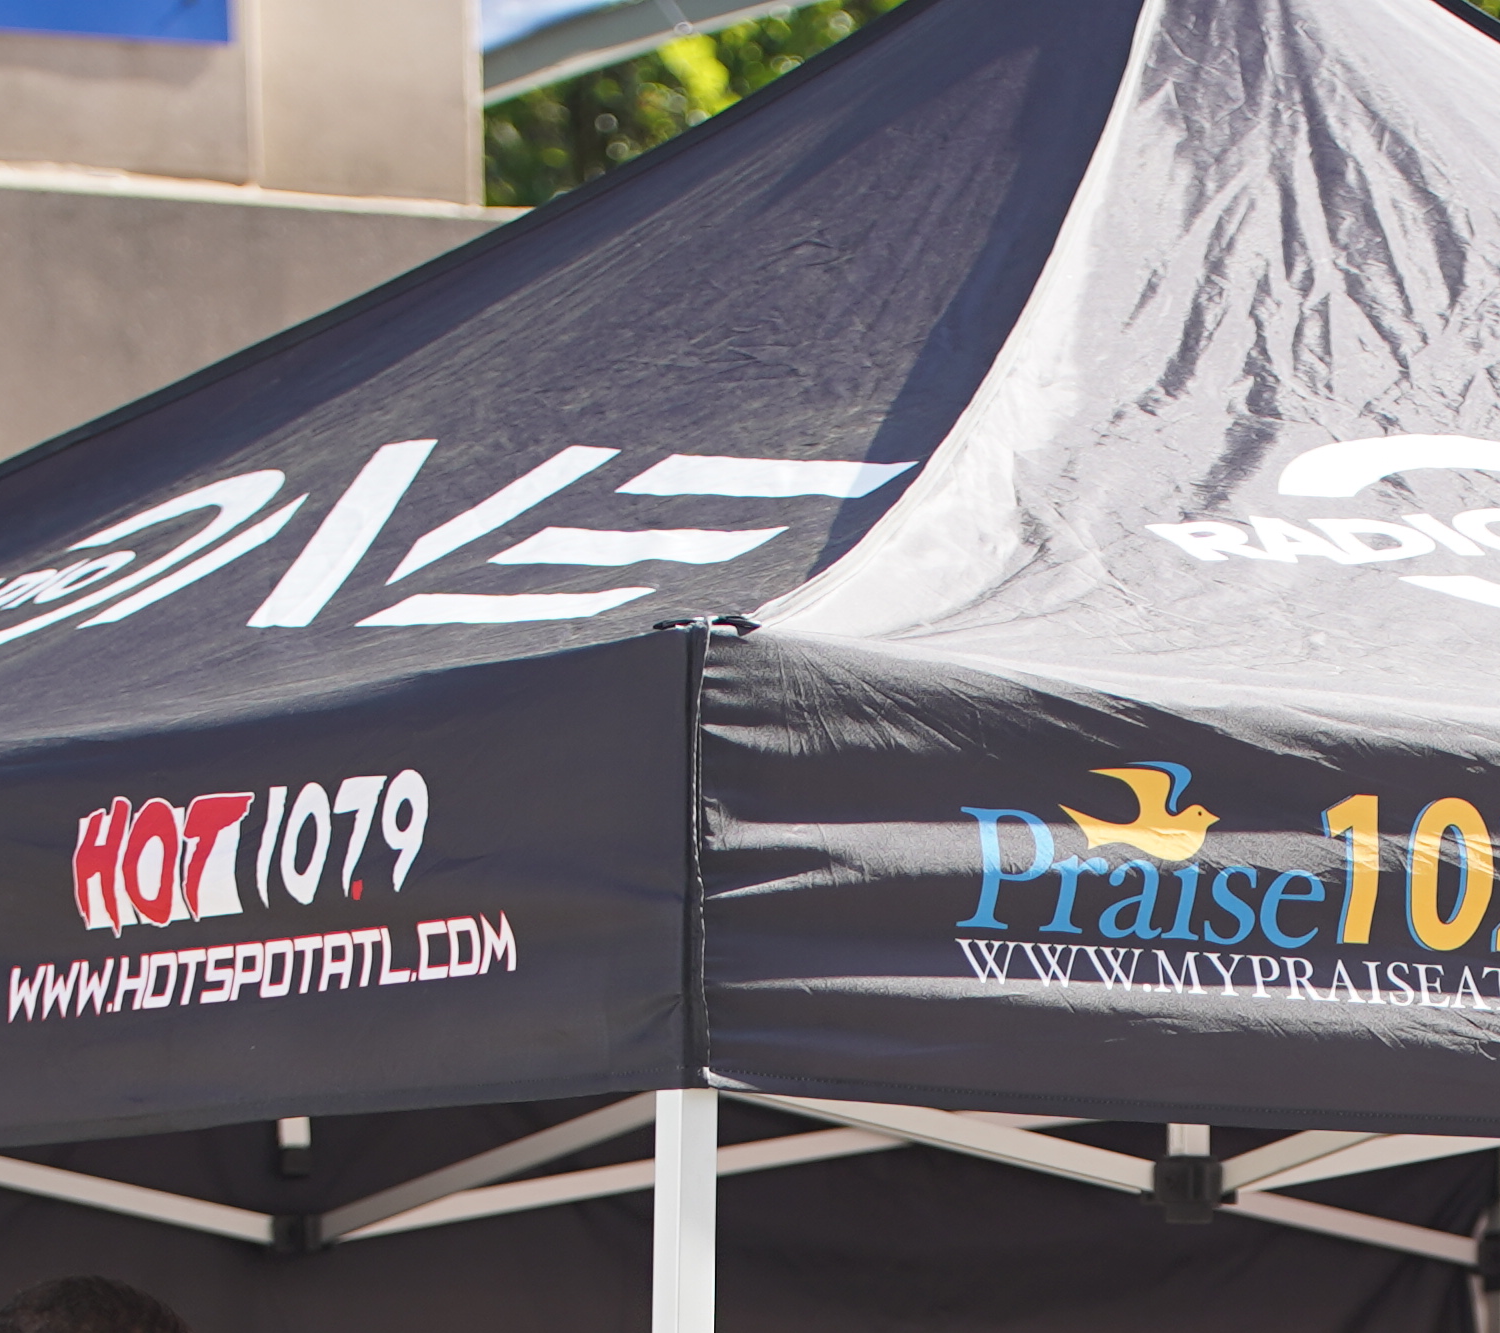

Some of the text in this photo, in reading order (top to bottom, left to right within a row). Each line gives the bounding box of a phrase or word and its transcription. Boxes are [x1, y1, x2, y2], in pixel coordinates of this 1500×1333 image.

[72, 796, 256, 938] HOT
[956, 803, 1326, 950] Praise
[8, 910, 518, 1024] WWW.HOTSPOTATL.COM
